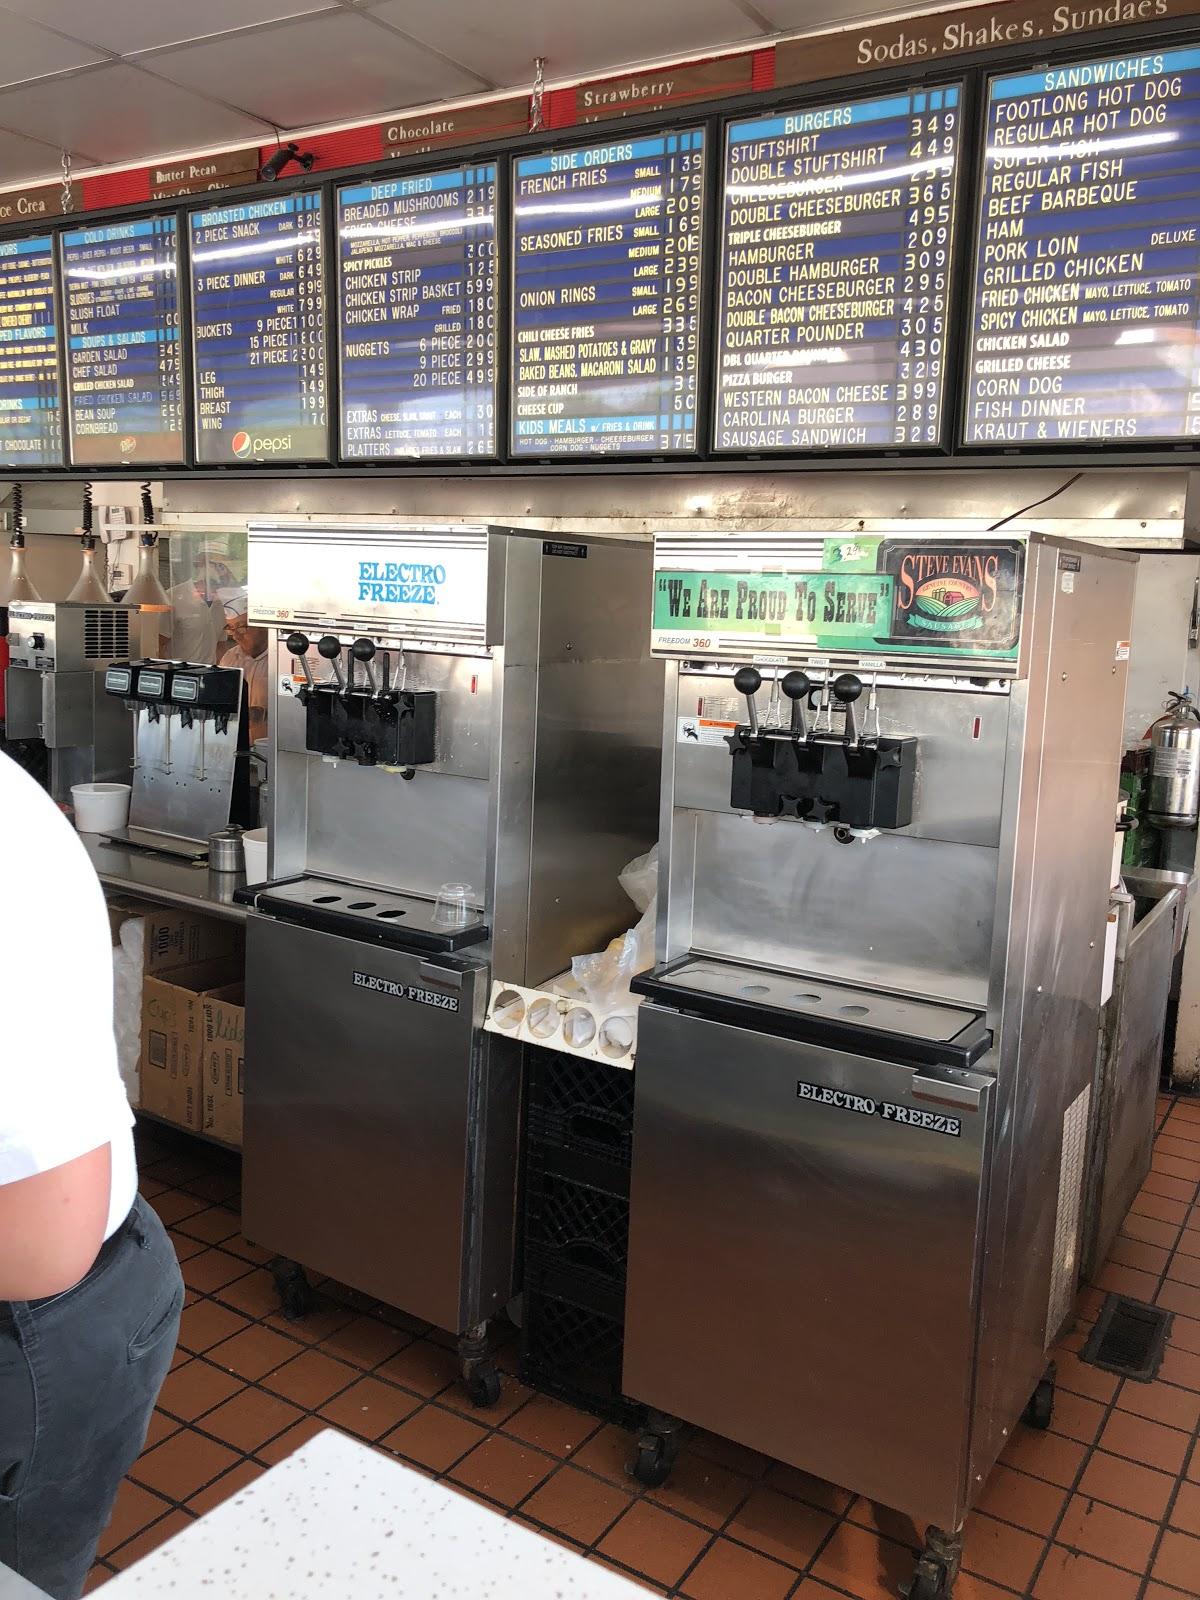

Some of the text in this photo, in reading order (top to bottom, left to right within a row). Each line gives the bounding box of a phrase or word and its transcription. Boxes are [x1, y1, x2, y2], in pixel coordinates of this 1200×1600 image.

[1052, 0, 1168, 33] Sundaes
[1045, 56, 1164, 91] SANDWICHES
[584, 81, 674, 107] Strawberry
[996, 78, 1181, 123] FOOTLONG HOT DOG
[388, 121, 455, 141] Chocolate
[785, 108, 851, 134] BURGERS
[551, 144, 632, 172] SIDE ORDERS
[731, 160, 785, 184] DOUBLE
[793, 146, 887, 175] STUFTSHIRT
[156, 165, 216, 185] Butter Pecan
[991, 159, 1123, 194] REGULAR FISH
[371, 178, 432, 200] DEEP FRIED
[988, 180, 1138, 217] BEEF BARBEQUE
[202, 201, 286, 226] BROASTED CHICKEN
[345, 192, 459, 222] BREADED MUSHROOMS
[85, 225, 134, 243] COLD DRINKS
[728, 220, 841, 245] TRIPLE CHEESEBURGER
[986, 219, 1023, 240] HAM
[629, 246, 659, 258] MEDIUM
[729, 243, 814, 266] HAMBURGER
[984, 229, 1196, 263] PORK LOIN DELUXE
[344, 257, 392, 272] SPICY PICKLES
[984, 253, 1143, 285] GRILLED CHICKEN
[198, 271, 294, 291] 3 PIECE DINNER DARK
[346, 282, 461, 307] CHICKEN STRIP BASKET
[520, 285, 657, 307] ONION RINGS SMALL
[70, 304, 120, 320] SLUSH FLOAT
[277, 304, 294, 313] WHITE
[633, 304, 657, 316] LARGE
[15, 327, 46, 339] FLAVORS
[71, 323, 88, 335] MILK
[197, 317, 291, 338] BUCKETS 9 PIECE
[726, 322, 864, 348] QUARTER POUNDER
[82, 331, 145, 348] SOUPS SALADS
[250, 333, 288, 349] 15 PIECE
[346, 336, 461, 357] NUGGETS 6 PIECE
[544, 339, 656, 360] MASHED POTATOES & GRAVY
[73, 348, 127, 363] GARDEN SALAD
[251, 350, 288, 365] 21 PIECE
[724, 353, 741, 367] DBL
[73, 364, 117, 378] CHEF SALAD
[201, 372, 215, 384] LEG
[414, 374, 426, 387] 20
[432, 371, 461, 386] PIECE
[520, 358, 656, 381] BAKED MACARONI SALAD
[200, 387, 224, 399] THIGH
[518, 383, 578, 398] SIDE OF RANCH
[724, 385, 888, 408] WESTERN BACON CHEESE
[977, 376, 1062, 397] CORN DOG
[75, 408, 115, 421] BEAN SOUP
[200, 401, 231, 415] BREAST
[518, 403, 564, 415] CHEESE CUP
[723, 407, 854, 427] CAROLINA BURGER
[76, 422, 118, 434] CORNBREAD
[202, 417, 222, 429] WING
[519, 420, 655, 435] KIDS MEALS FRIES DRINK
[974, 418, 1137, 440] KRAUT & WIENERS
[347, 427, 381, 440] EXTRAS
[723, 430, 784, 447] SAUSAGE
[792, 428, 866, 445] SANDWICH
[254, 435, 291, 453] pepsi
[348, 443, 390, 456] PLATTERS
[359, 562, 446, 585] ELECTRO
[898, 555, 999, 612] STEVE EVANS
[358, 582, 436, 605] FREEZE
[693, 638, 711, 648] 360
[159, 927, 169, 956] 1000
[354, 972, 458, 1011] ELECTRO FREEZE
[798, 1083, 959, 1135] ELECTRO FREEZE
